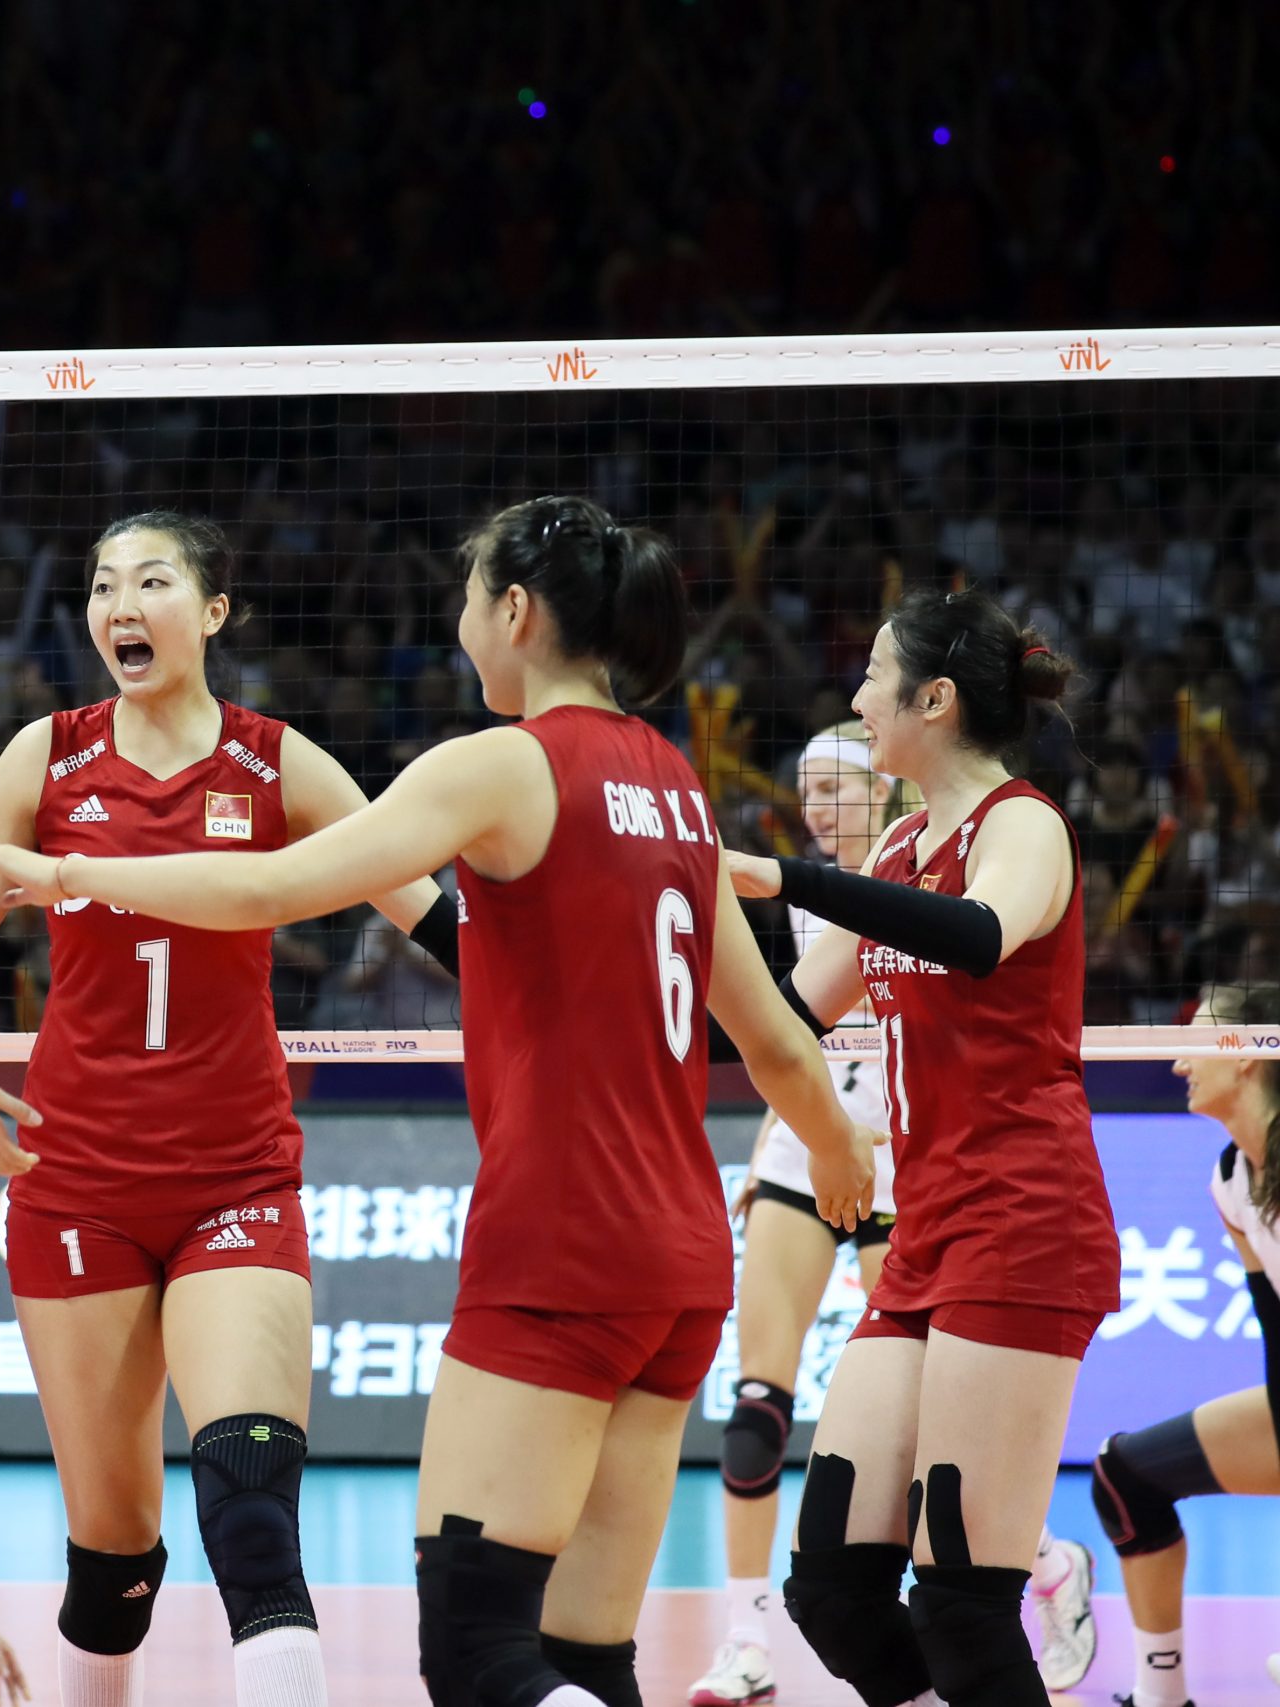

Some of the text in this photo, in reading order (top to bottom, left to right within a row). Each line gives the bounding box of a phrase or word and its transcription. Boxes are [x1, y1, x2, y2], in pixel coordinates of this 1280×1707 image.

[548, 347, 597, 382] VNL
[1060, 337, 1111, 371] VNL
[47, 357, 95, 389] VNL
[49, 739, 106, 782] 腾讯体育
[221, 739, 280, 784] 腾讯体育
[69, 811, 109, 822] adidas
[211, 821, 246, 834] CHN
[603, 781, 665, 840] GONG
[655, 887, 693, 1064] 6
[869, 981, 894, 1001] CPIC
[136, 938, 169, 1050] 1
[386, 1041, 418, 1049] FIVB
[1216, 1032, 1247, 1050] VNL
[880, 1013, 910, 1134] 11
[60, 1228, 84, 1276] 1
[206, 1238, 256, 1250] adidas
